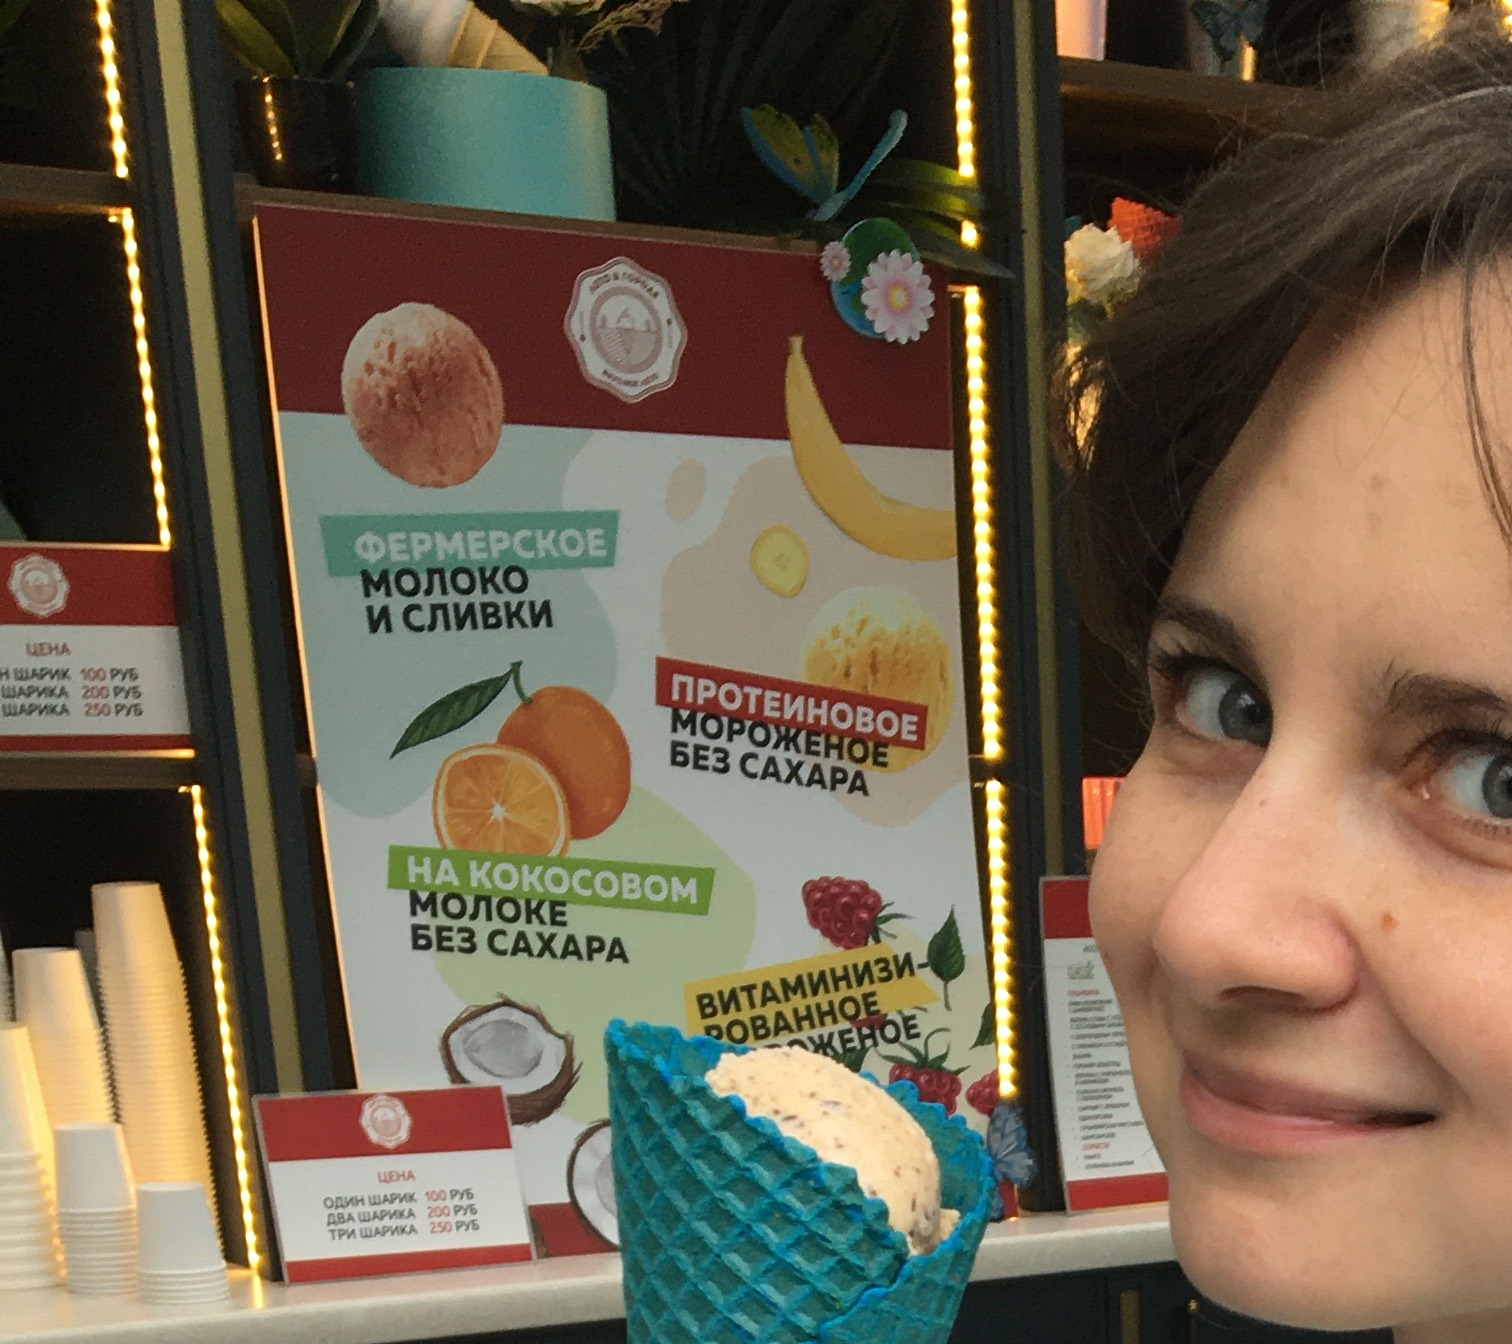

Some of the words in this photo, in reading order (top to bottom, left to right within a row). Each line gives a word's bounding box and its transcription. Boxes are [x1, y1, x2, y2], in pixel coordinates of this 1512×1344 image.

[355, 527, 608, 563] ФЕРМЕРСКОЕ
[360, 565, 529, 598] МОЛОКО
[365, 604, 393, 634] И
[402, 599, 554, 633] СЛИВКИ
[25, 641, 72, 657] ЦЕНА
[13, 667, 72, 682] ШАРИК
[79, 666, 107, 682] 100
[109, 667, 139, 682] РУБ
[1, 684, 70, 700] ШАРИКА
[82, 684, 110, 700] 200
[113, 684, 142, 700] РУБ
[671, 673, 919, 742] ПРОТЕИНОВОЕ
[2, 702, 72, 718] ШАРИКА
[84, 702, 112, 718] 250
[114, 702, 144, 718] РУБ
[670, 707, 890, 768] МОРОЖЕНОЕ
[669, 739, 731, 775] БЕЗ
[739, 751, 870, 797] САХАРА
[407, 855, 460, 887] НА
[469, 860, 699, 905] КОКОСОВОМ
[408, 889, 569, 927] МОЛОКЕ
[410, 923, 478, 955] БЕЗ
[486, 928, 630, 964] САХАРА
[703, 990, 882, 1045] РОВАННОЕ
[376, 1169, 416, 1184] ЦЕНА
[322, 1195, 365, 1211] ОДИН
[367, 1192, 418, 1207] ШАРИК
[424, 1189, 447, 1203] 100
[449, 1187, 475, 1201] РУБ
[326, 1211, 356, 1227] ДВА
[357, 1207, 417, 1223] ШАРИКА
[426, 1205, 451, 1218] 200
[453, 1203, 478, 1217] РУБ
[328, 1227, 357, 1242] ТРИ
[359, 1223, 418, 1239] ШАРИКА
[428, 1221, 453, 1234] 250
[455, 1219, 480, 1233] РУБ
